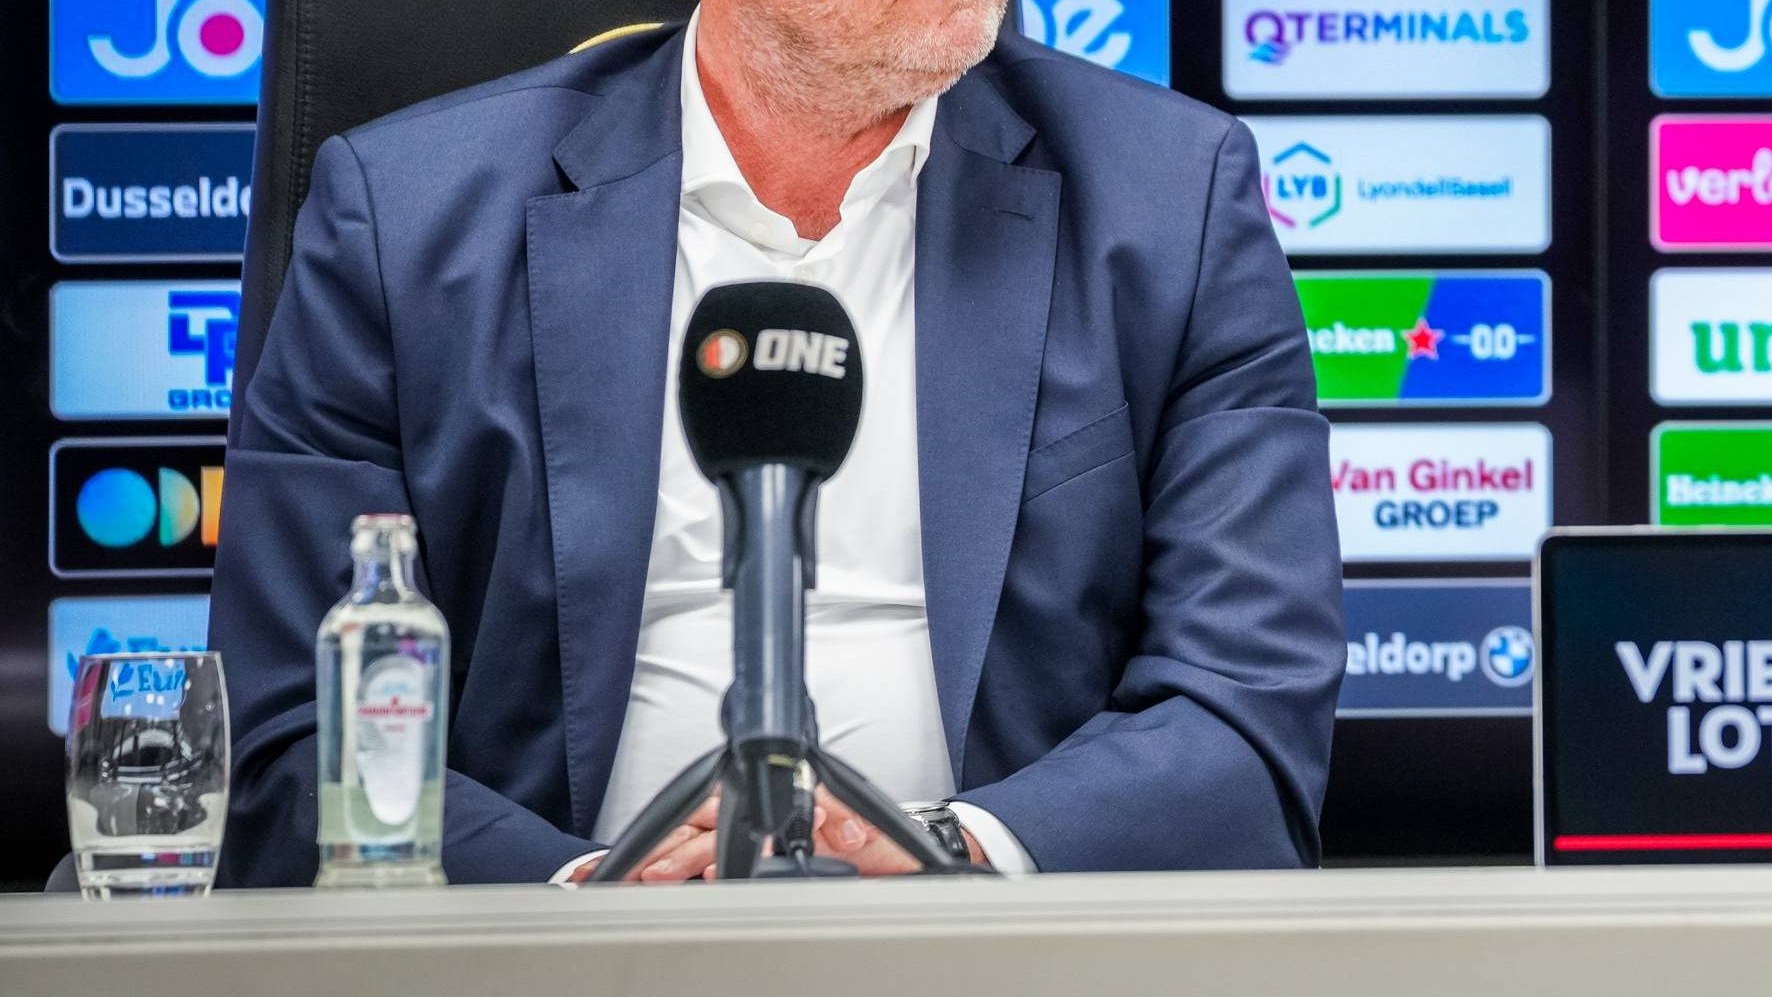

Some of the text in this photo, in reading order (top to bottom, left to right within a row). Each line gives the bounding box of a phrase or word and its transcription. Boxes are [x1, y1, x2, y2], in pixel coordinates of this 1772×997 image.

[1245, 8, 1528, 65] QTERMINALS
[1276, 174, 1328, 199] LYB
[753, 328, 849, 379] ONE
[1331, 459, 1533, 491] Van Ginkel
[1374, 501, 1498, 529] GROEP
